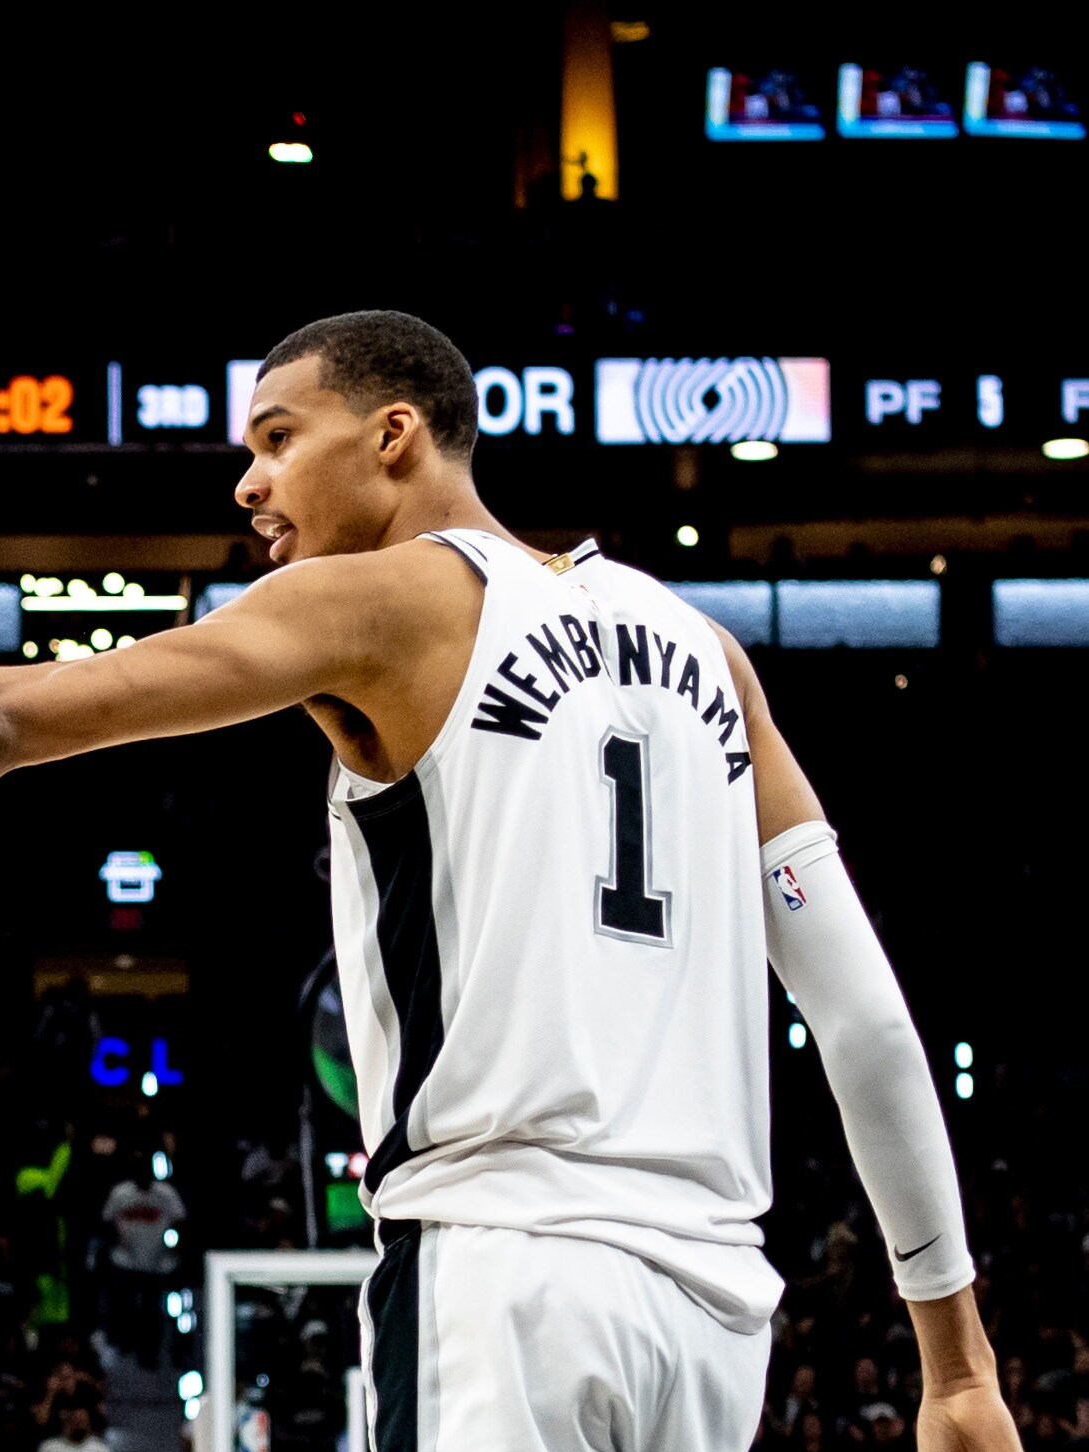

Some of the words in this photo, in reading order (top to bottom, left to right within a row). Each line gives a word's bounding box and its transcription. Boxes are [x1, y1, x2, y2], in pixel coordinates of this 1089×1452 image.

[475, 366, 575, 436] OR
[865, 380, 941, 424] PF
[593, 725, 674, 949] 1
